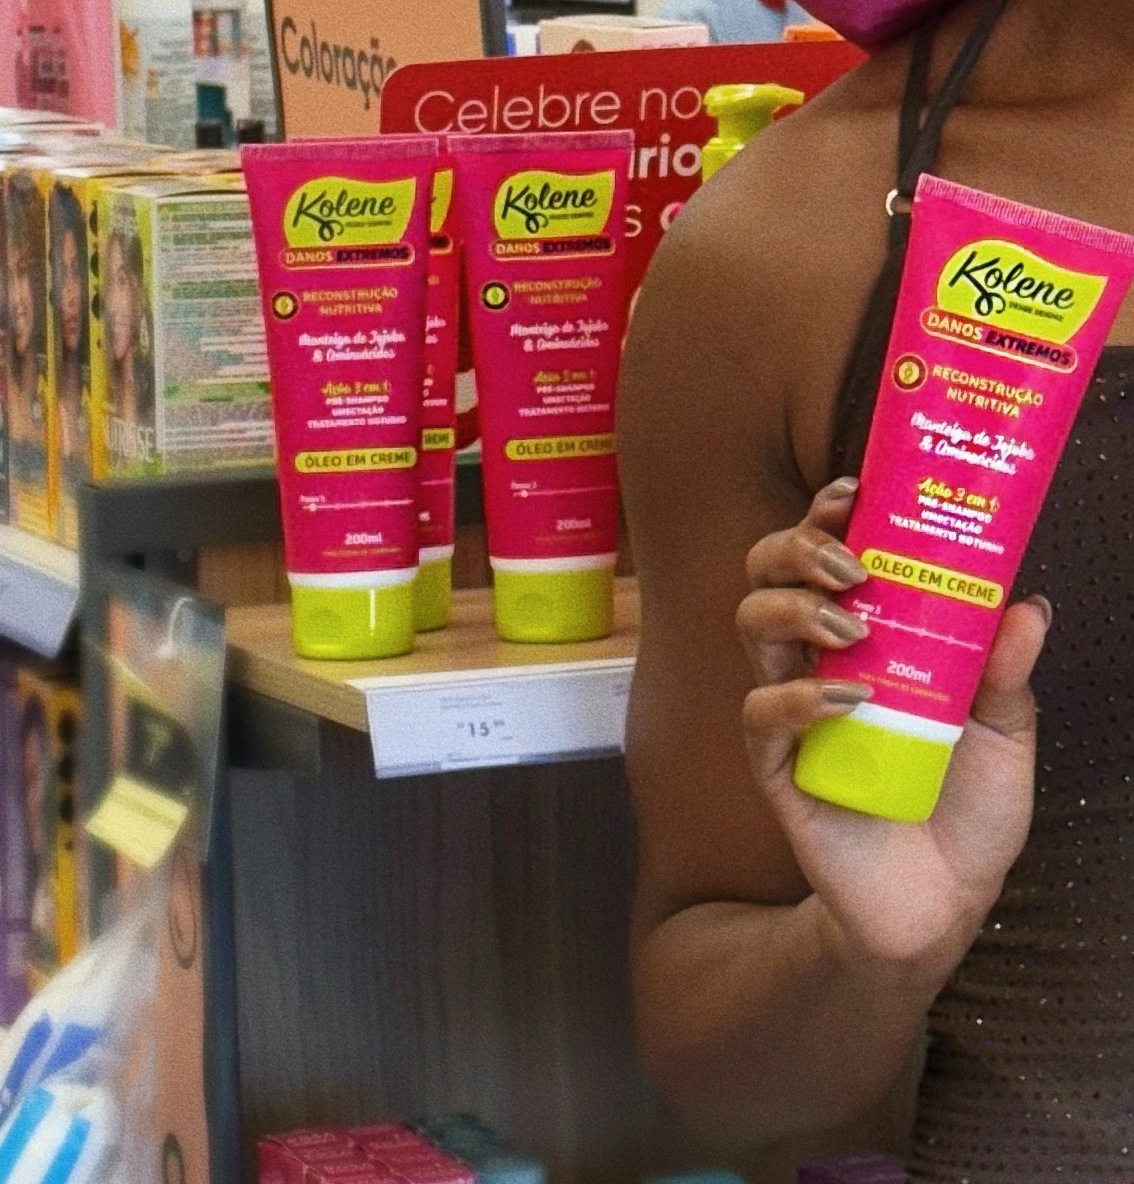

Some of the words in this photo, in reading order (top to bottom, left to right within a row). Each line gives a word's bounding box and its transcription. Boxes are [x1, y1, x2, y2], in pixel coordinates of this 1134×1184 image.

[414, 82, 621, 136] Celebre
[627, 132, 703, 181] rio
[292, 188, 398, 243] Kolene
[500, 181, 599, 234] Kolene
[285, 250, 334, 266] DANOS
[948, 250, 1075, 316] Kolene
[926, 312, 984, 341] DANOS
[984, 329, 1073, 366] EXTREMOS
[932, 364, 1045, 407] RECONSTRUÇÃO
[946, 385, 1021, 419] NUTRITIVA
[304, 453, 342, 469] ÓLEO
[346, 454, 367, 467] EM
[370, 449, 412, 465] CREME
[515, 442, 553, 456] ÓLEO
[556, 441, 576, 454] EM
[344, 530, 384, 545] 200ml
[870, 553, 915, 579] ÓLEO
[917, 568, 943, 588] EM
[946, 576, 999, 603] CREME
[886, 658, 933, 686] 200ml
